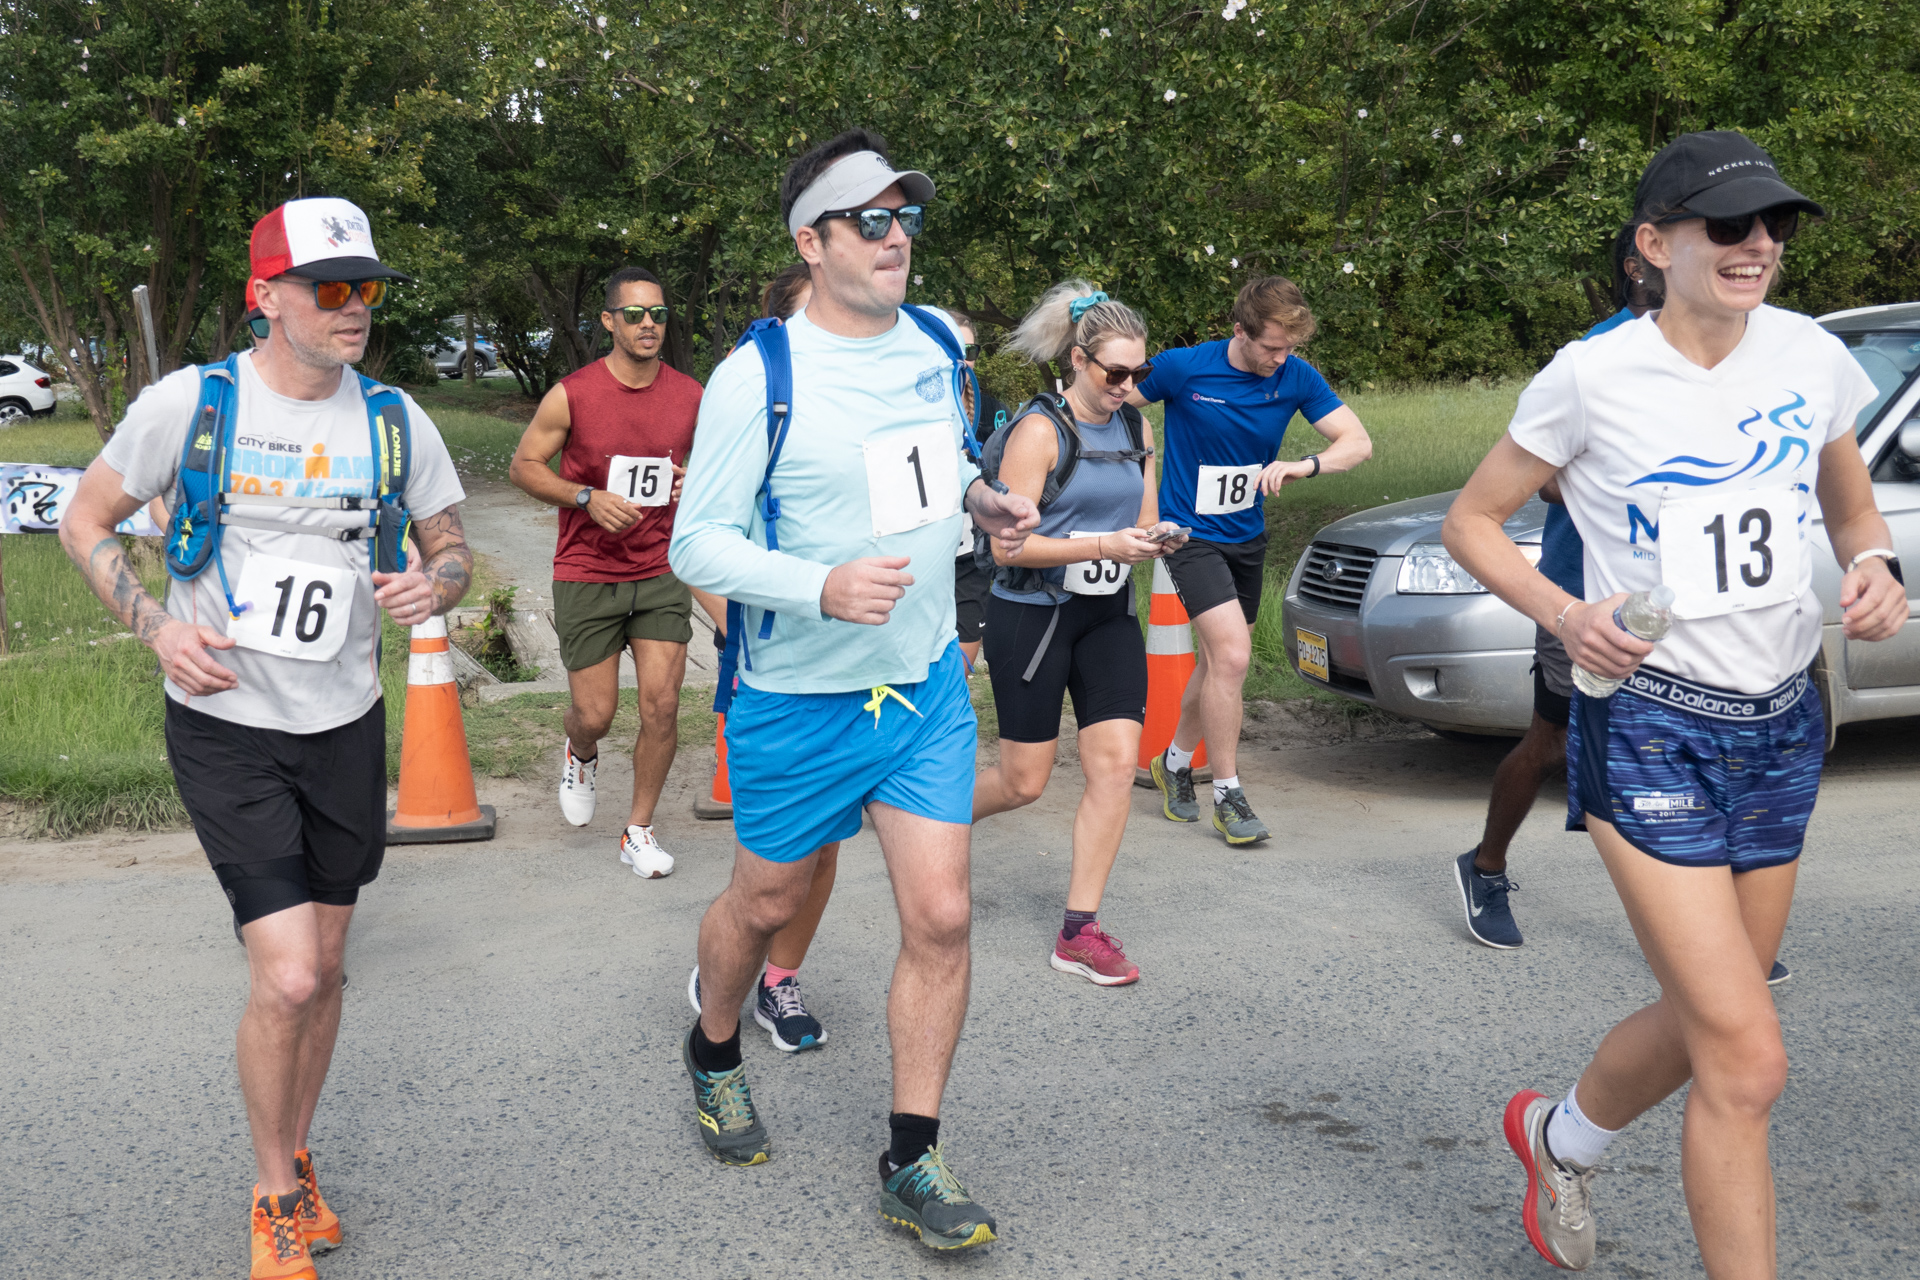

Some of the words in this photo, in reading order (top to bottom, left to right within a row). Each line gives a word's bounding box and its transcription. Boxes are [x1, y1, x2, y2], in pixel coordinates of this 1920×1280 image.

[1708, 160, 1751, 176] NECKER
[1755, 160, 1775, 171] ISLA
[238, 436, 265, 449] CITY
[268, 442, 303, 453] BIKES
[390, 424, 402, 477] AONIJIE
[231, 443, 374, 480] IRONMAN
[906, 446, 928, 508] 1
[294, 481, 374, 498] Miami
[628, 465, 660, 498] 15
[1217, 473, 1248, 506] 18
[1633, 551, 1656, 561] MID
[1703, 508, 1773, 594] 13
[271, 575, 333, 643] 16
[1668, 684, 1755, 716] balance
[1770, 685, 1795, 712] new
[1670, 799, 1694, 808] MILE
